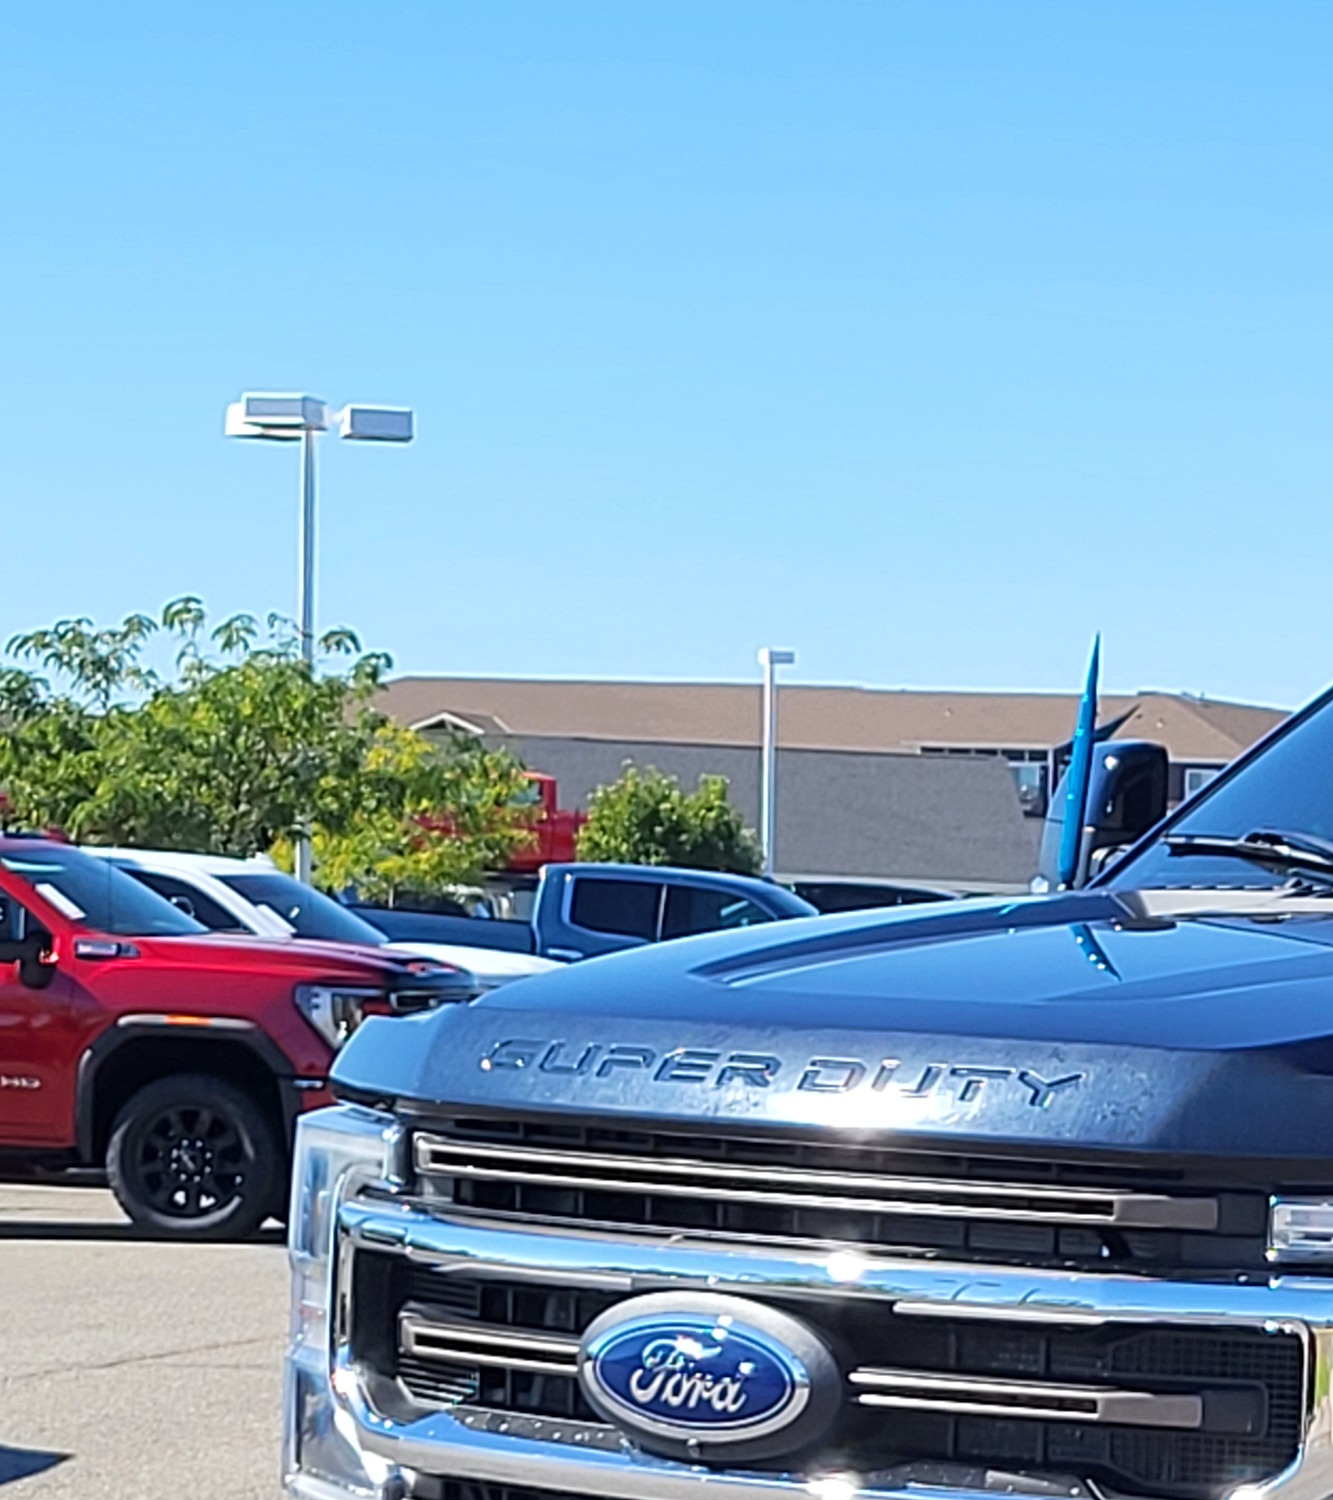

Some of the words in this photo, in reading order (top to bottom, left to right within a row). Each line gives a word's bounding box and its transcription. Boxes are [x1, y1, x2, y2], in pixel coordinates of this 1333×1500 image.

[481, 1037, 782, 1089] SUPER
[796, 1055, 1088, 1109] DUTY
[629, 1334, 748, 1414] Ford
